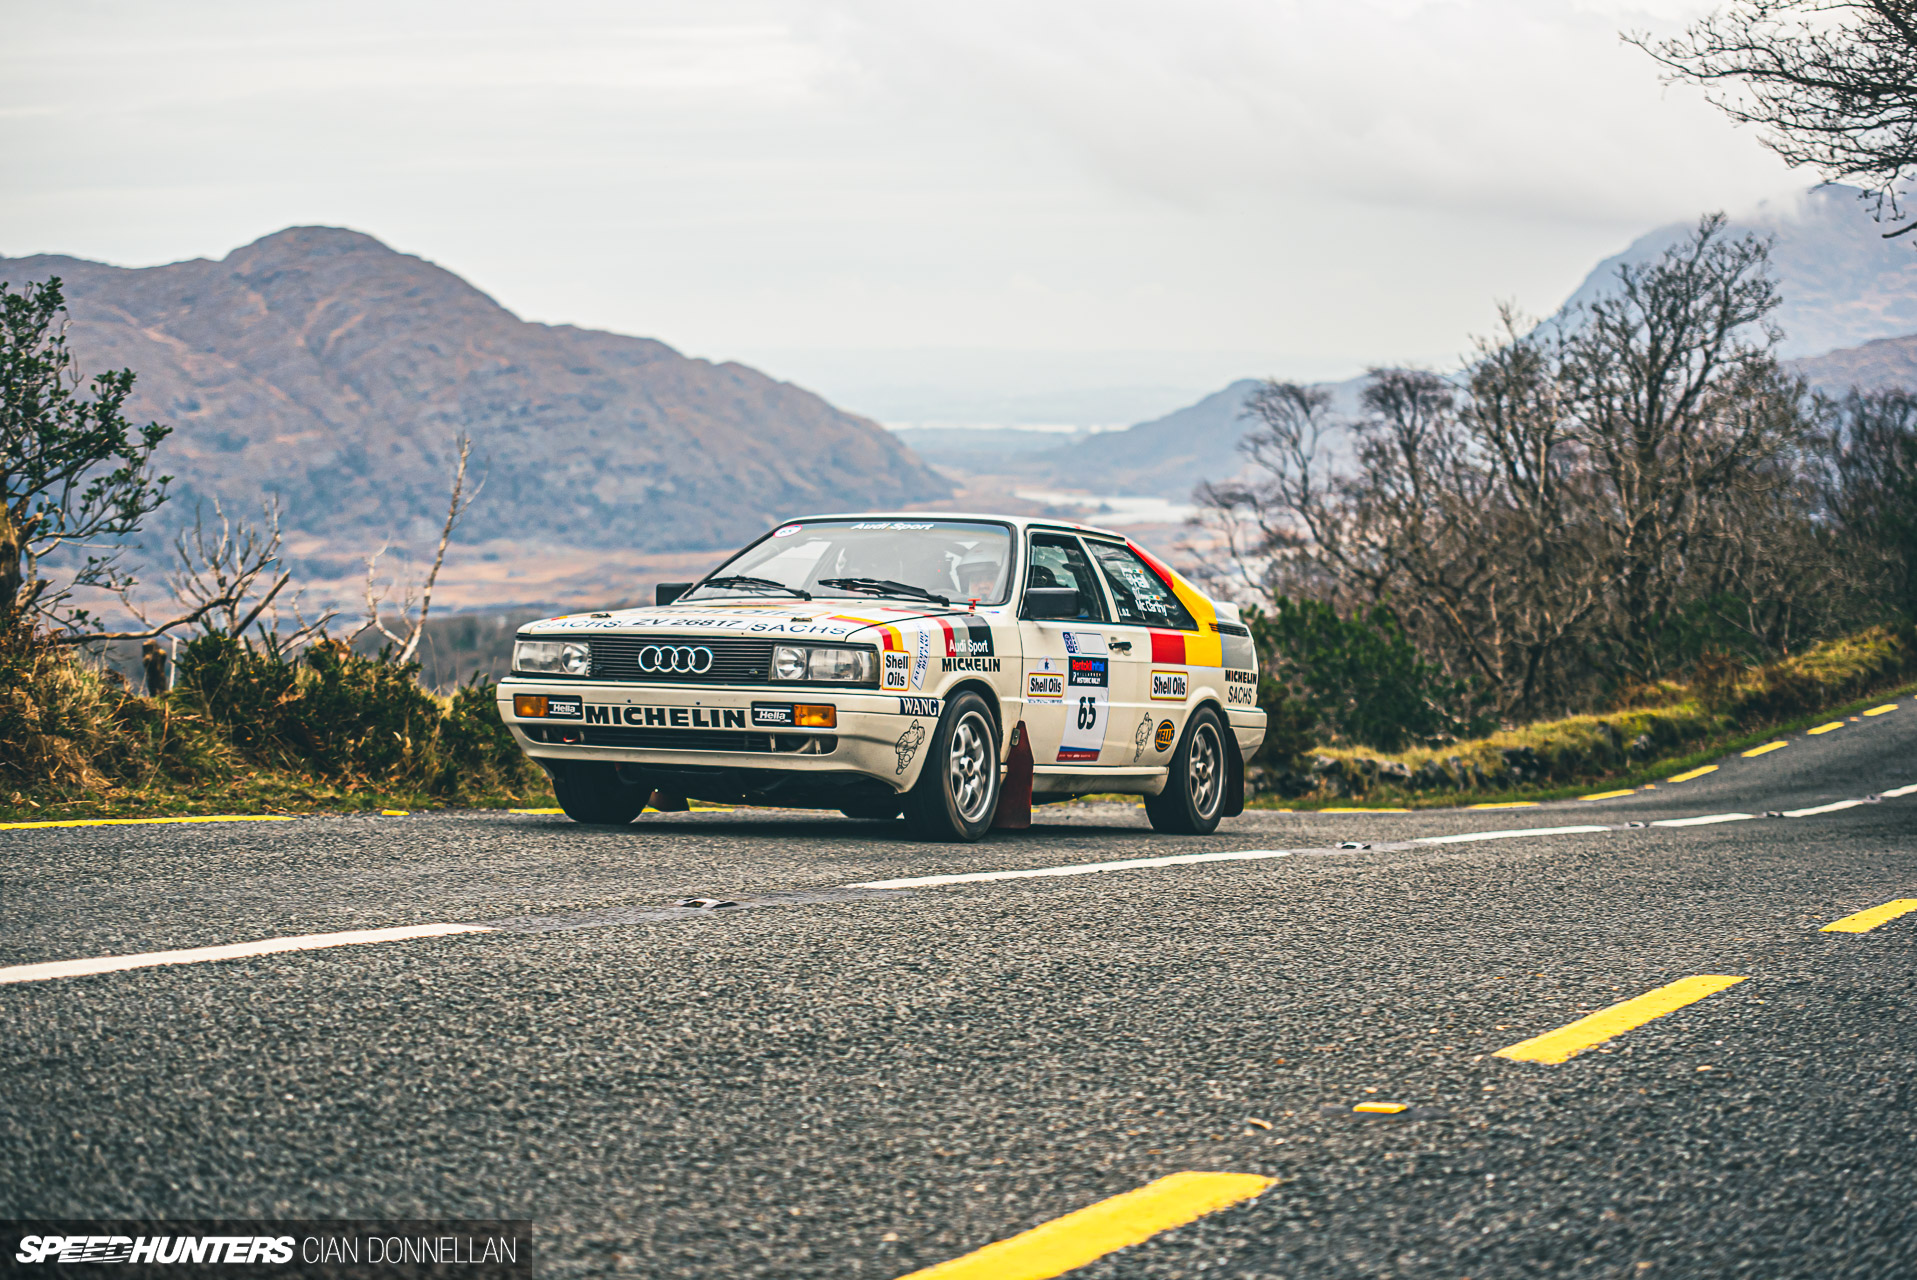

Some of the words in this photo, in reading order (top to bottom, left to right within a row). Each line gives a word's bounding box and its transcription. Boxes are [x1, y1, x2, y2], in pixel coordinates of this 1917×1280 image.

[850, 522, 889, 530] Audi
[889, 522, 935, 531] Sport
[537, 619, 622, 628] SACHS
[632, 618, 669, 626] ZV
[670, 618, 743, 628] 26817
[750, 623, 847, 635] SACHS
[948, 638, 967, 653] Audi
[967, 639, 989, 656] Sport
[885, 654, 909, 670] Shell
[941, 657, 1001, 673] MICHELIN
[887, 671, 905, 687] Oils
[1030, 677, 1048, 693] Shell
[1048, 678, 1062, 693] Oils
[1224, 669, 1258, 685] MICHELIN
[1153, 675, 1172, 695] Shell
[1172, 676, 1186, 696] Oils
[1227, 685, 1253, 705] SACHS
[553, 703, 577, 713] Hella
[900, 697, 937, 716] WANG
[1077, 696, 1097, 730] 65
[584, 705, 747, 729] MICHELIN
[759, 710, 786, 720] Hella
